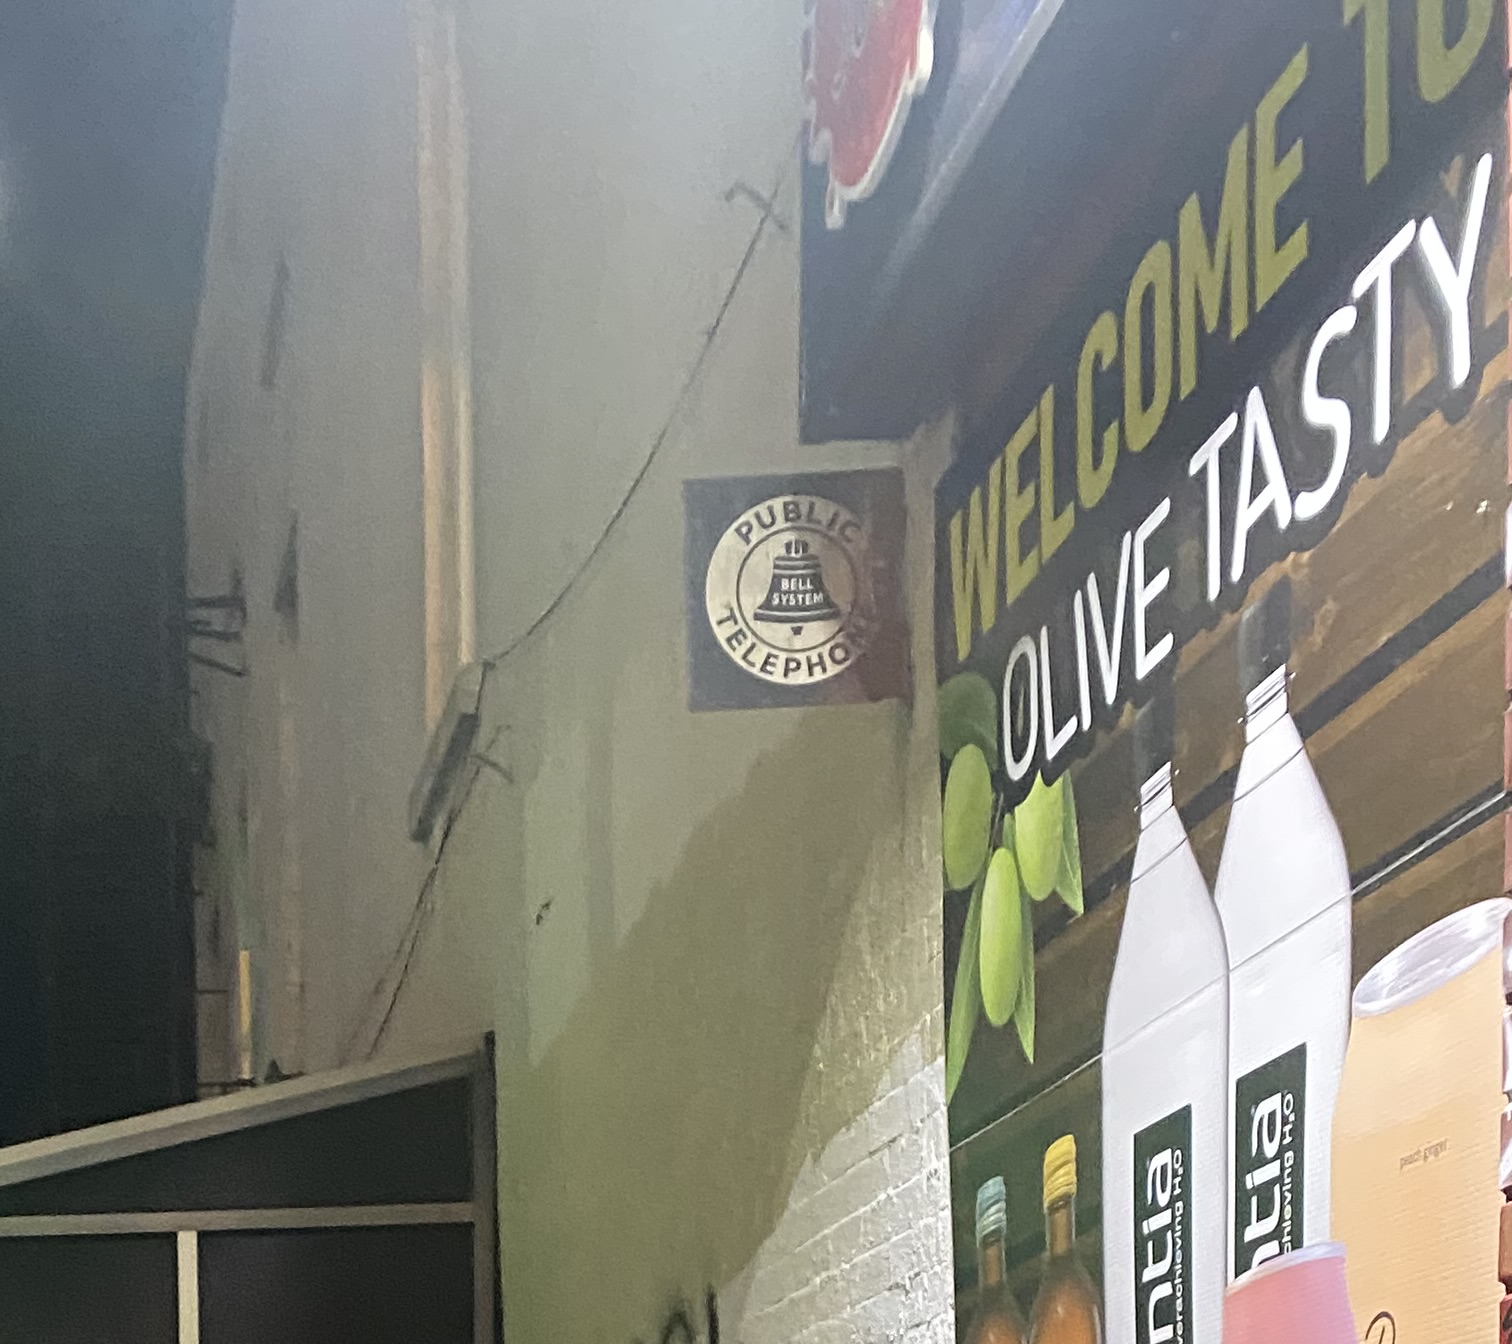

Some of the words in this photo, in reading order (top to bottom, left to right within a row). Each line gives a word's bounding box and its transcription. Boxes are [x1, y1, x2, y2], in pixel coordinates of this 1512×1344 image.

[948, 42, 1310, 662] WELCOME
[1003, 496, 1175, 781] OLIVE
[1188, 152, 1493, 603] TASTY
[734, 500, 862, 546] PUBLIC
[771, 591, 825, 607] SYSTEM
[781, 577, 814, 591] BELL
[715, 606, 868, 679] TELEPHO
